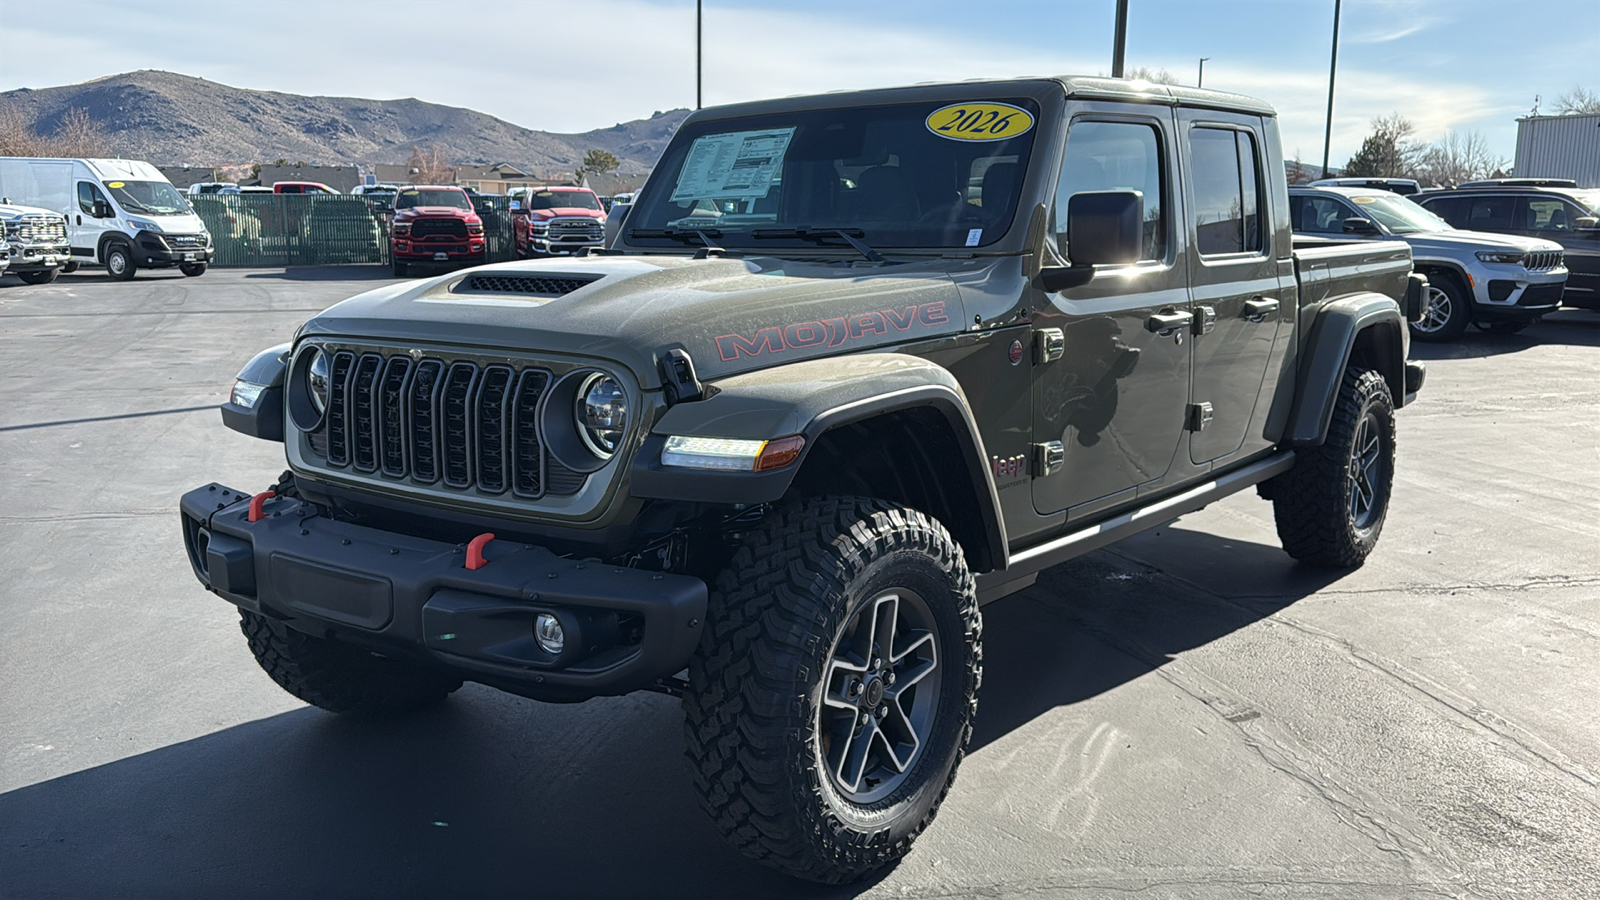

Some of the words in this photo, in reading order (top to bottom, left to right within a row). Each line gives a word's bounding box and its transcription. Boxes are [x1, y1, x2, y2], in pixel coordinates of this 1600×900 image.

[937, 109, 1020, 134] 2026
[714, 301, 949, 361] MOJAVE
[992, 453, 1026, 478] Jeep
